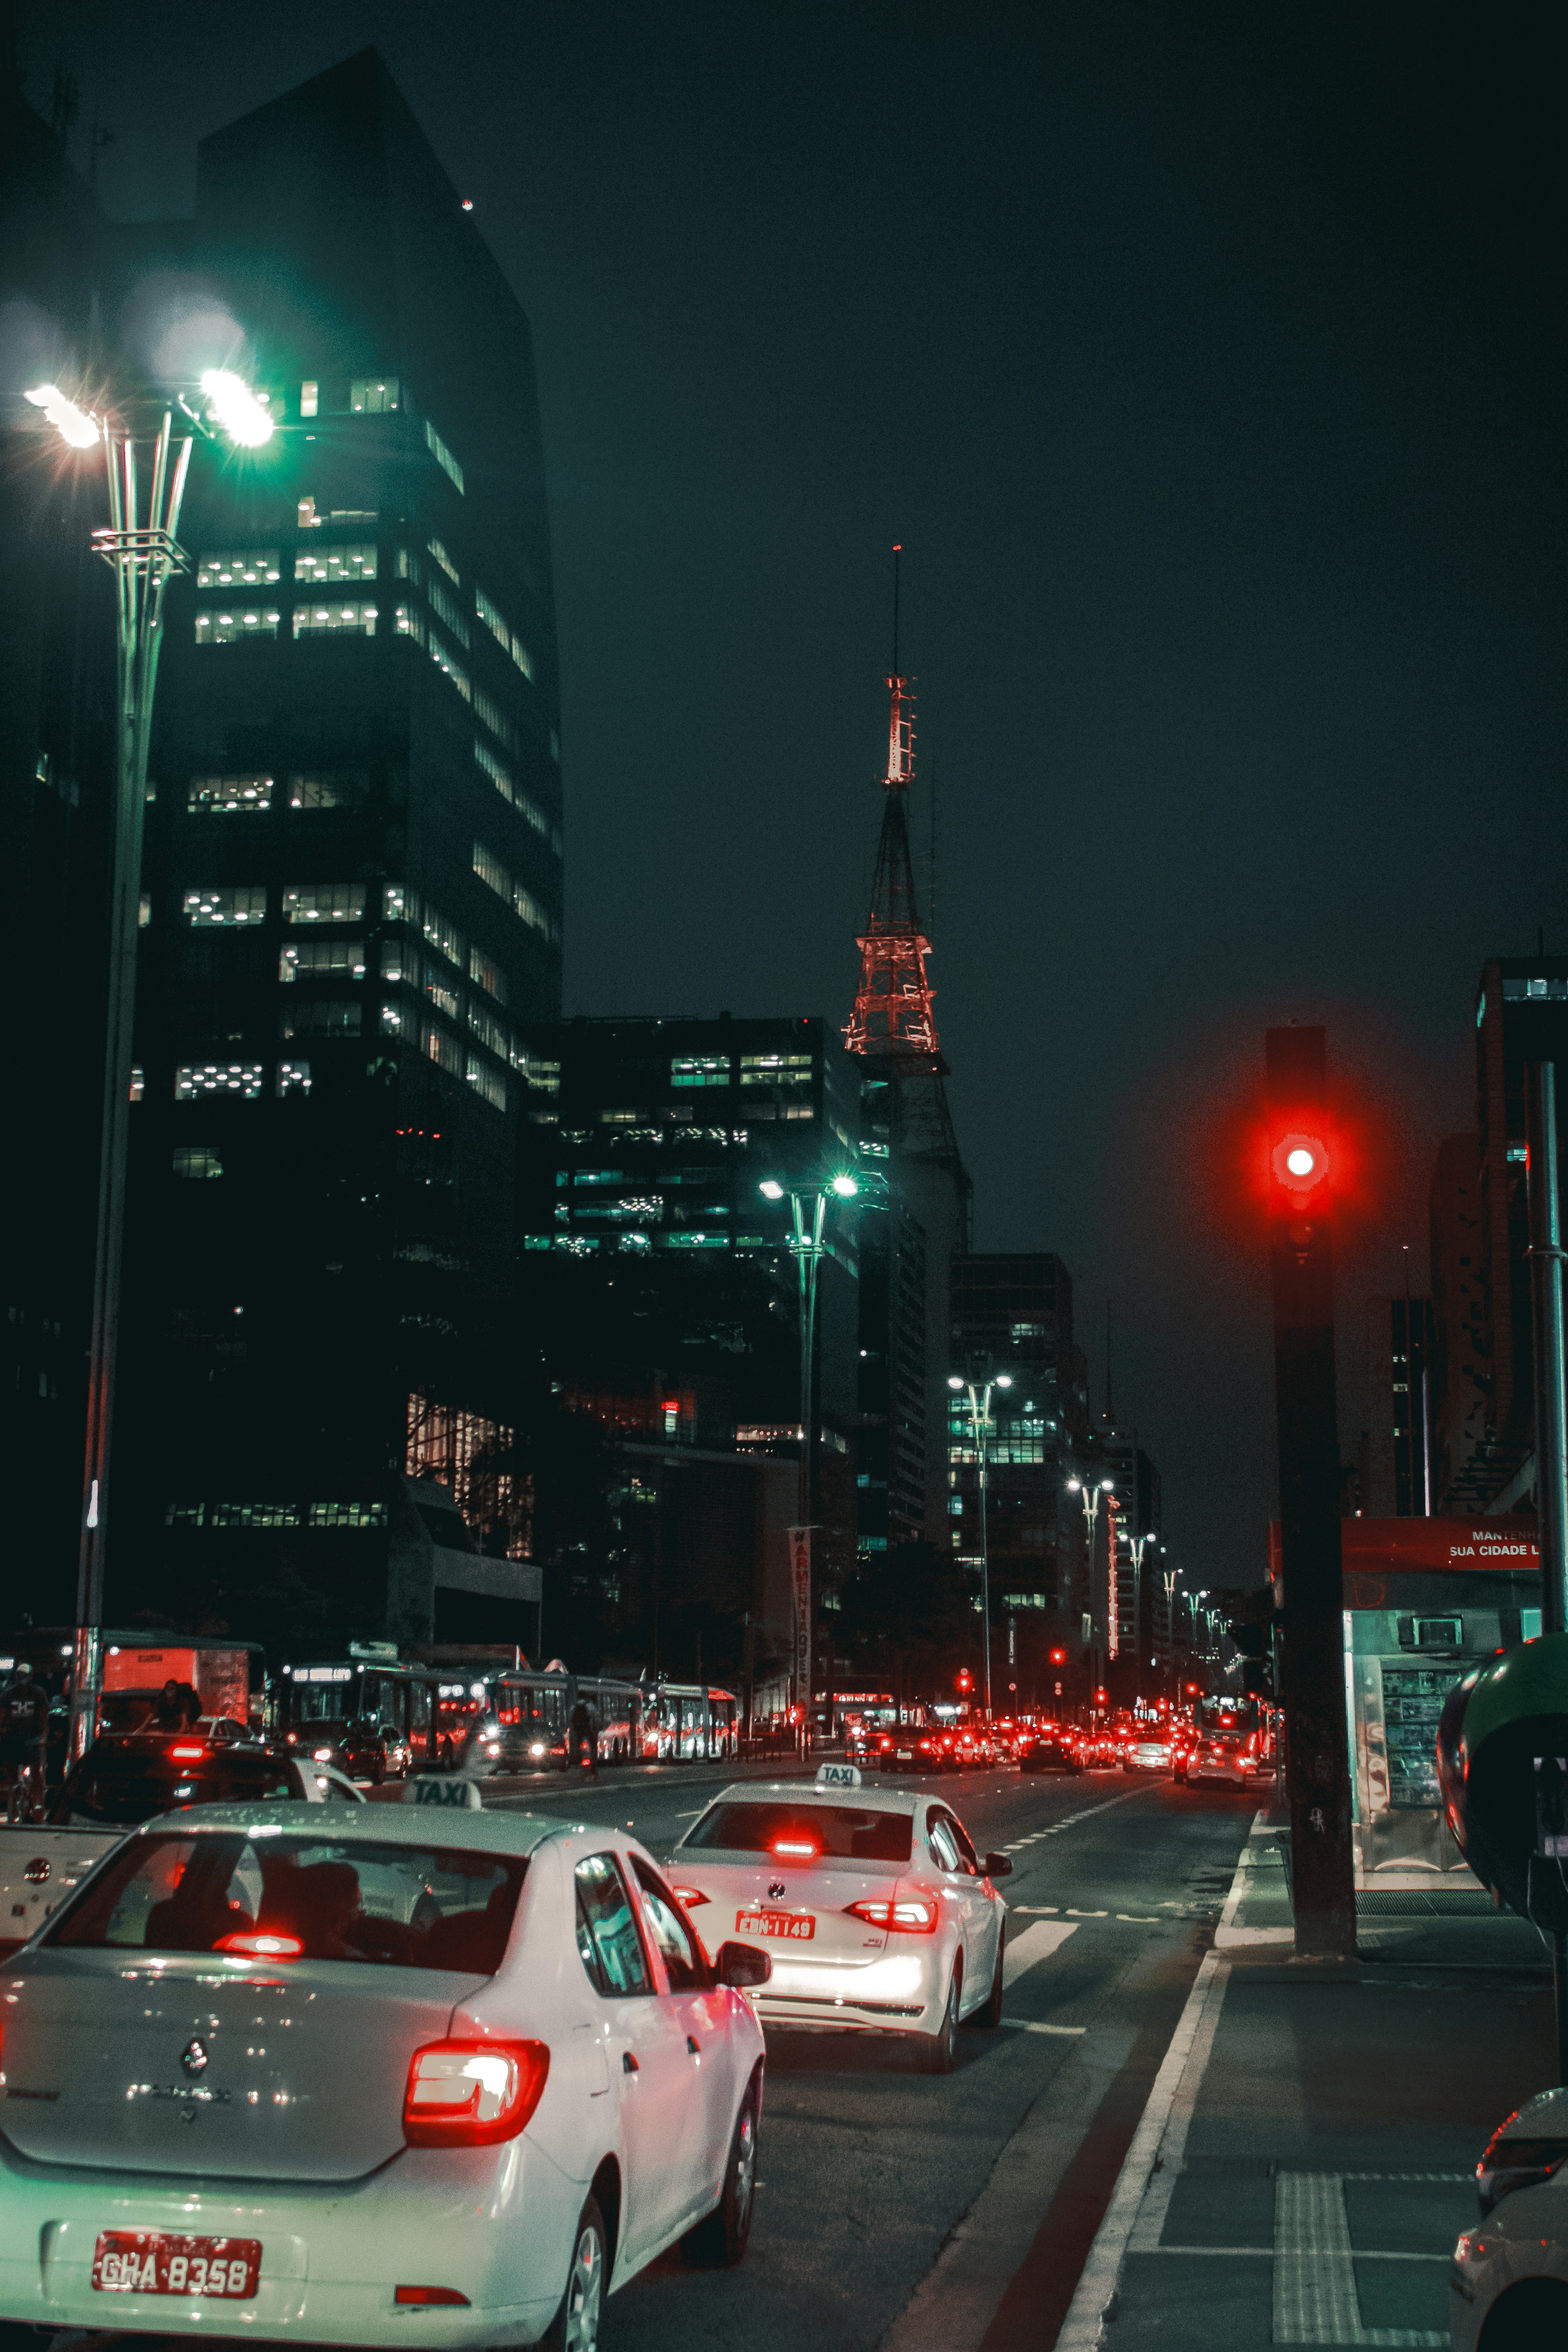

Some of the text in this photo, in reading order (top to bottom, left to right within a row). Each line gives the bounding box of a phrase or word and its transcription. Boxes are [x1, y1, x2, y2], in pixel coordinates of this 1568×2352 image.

[1472, 1530, 1536, 1541] MANTENH
[1450, 1545, 1539, 1556] SUA CIDADE L
[824, 1767, 853, 1785] TAXI
[413, 1781, 468, 1807] TAXI
